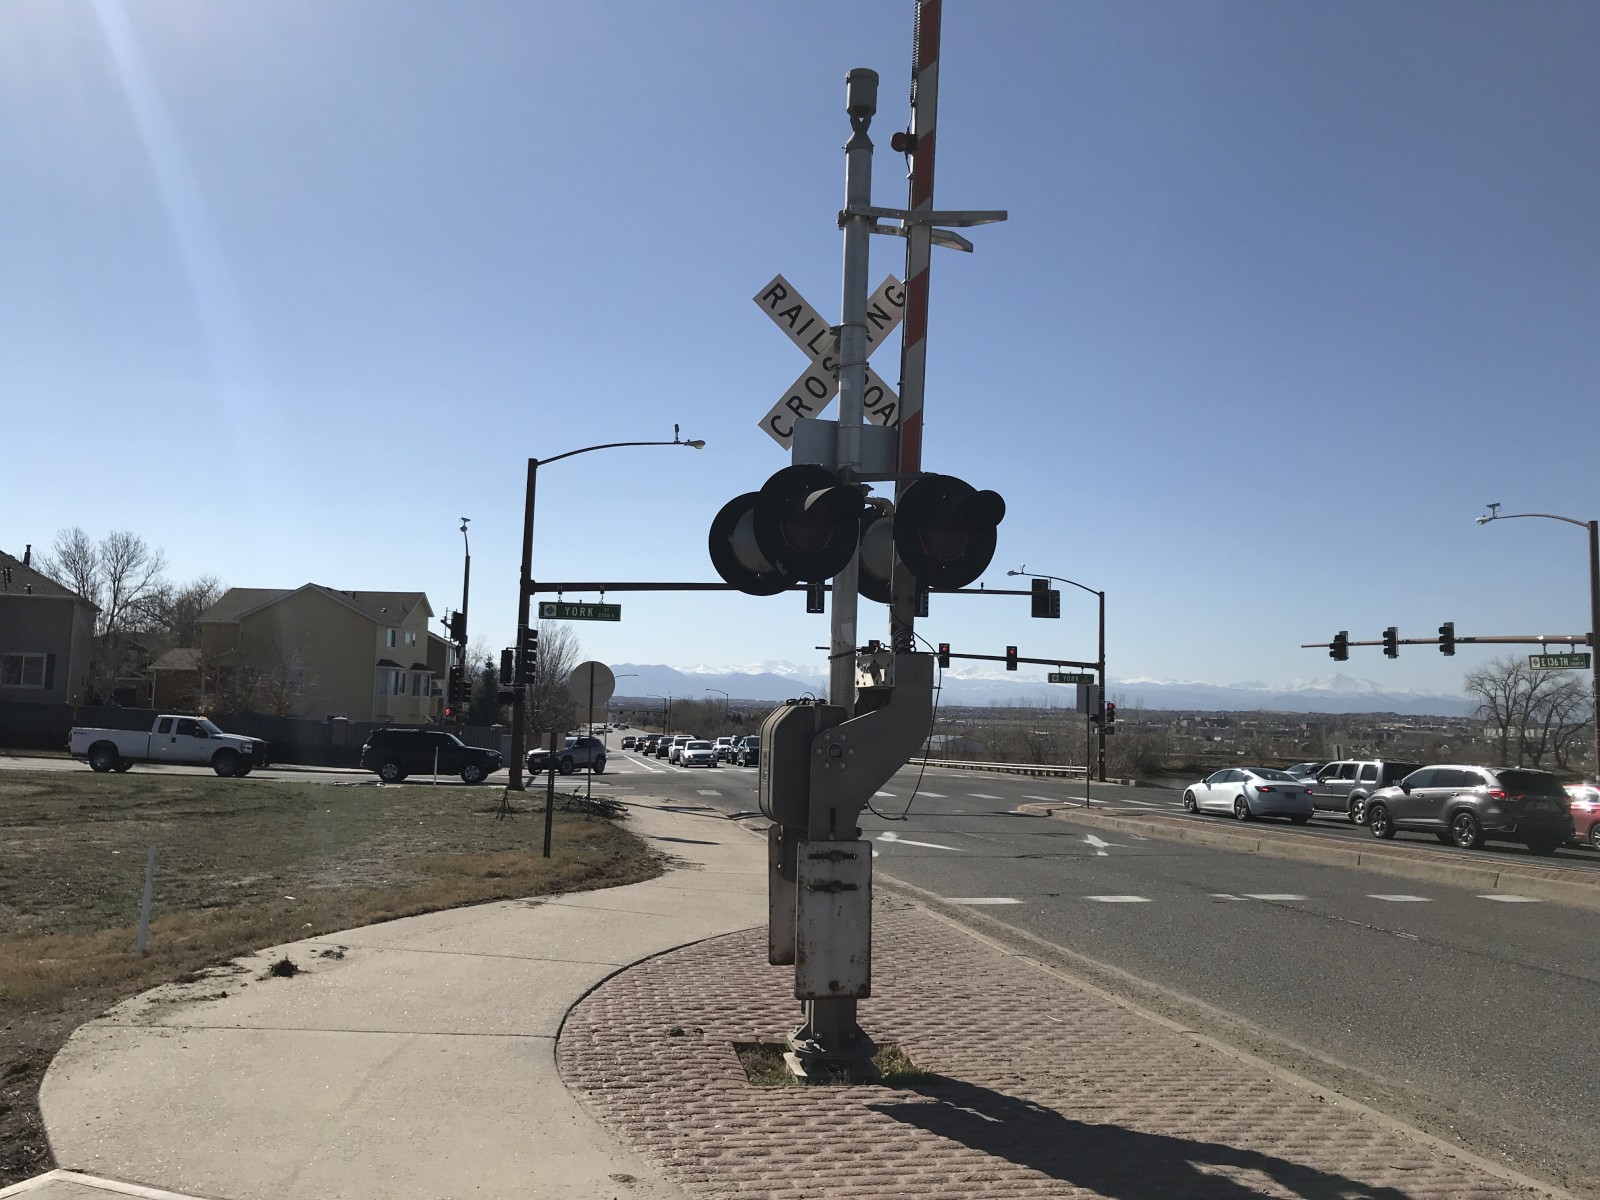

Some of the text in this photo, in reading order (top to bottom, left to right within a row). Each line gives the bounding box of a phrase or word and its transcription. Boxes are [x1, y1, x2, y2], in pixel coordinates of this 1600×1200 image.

[762, 282, 899, 427] RAILOA
[564, 606, 594, 617] YORK
[1541, 658, 1547, 667] E
